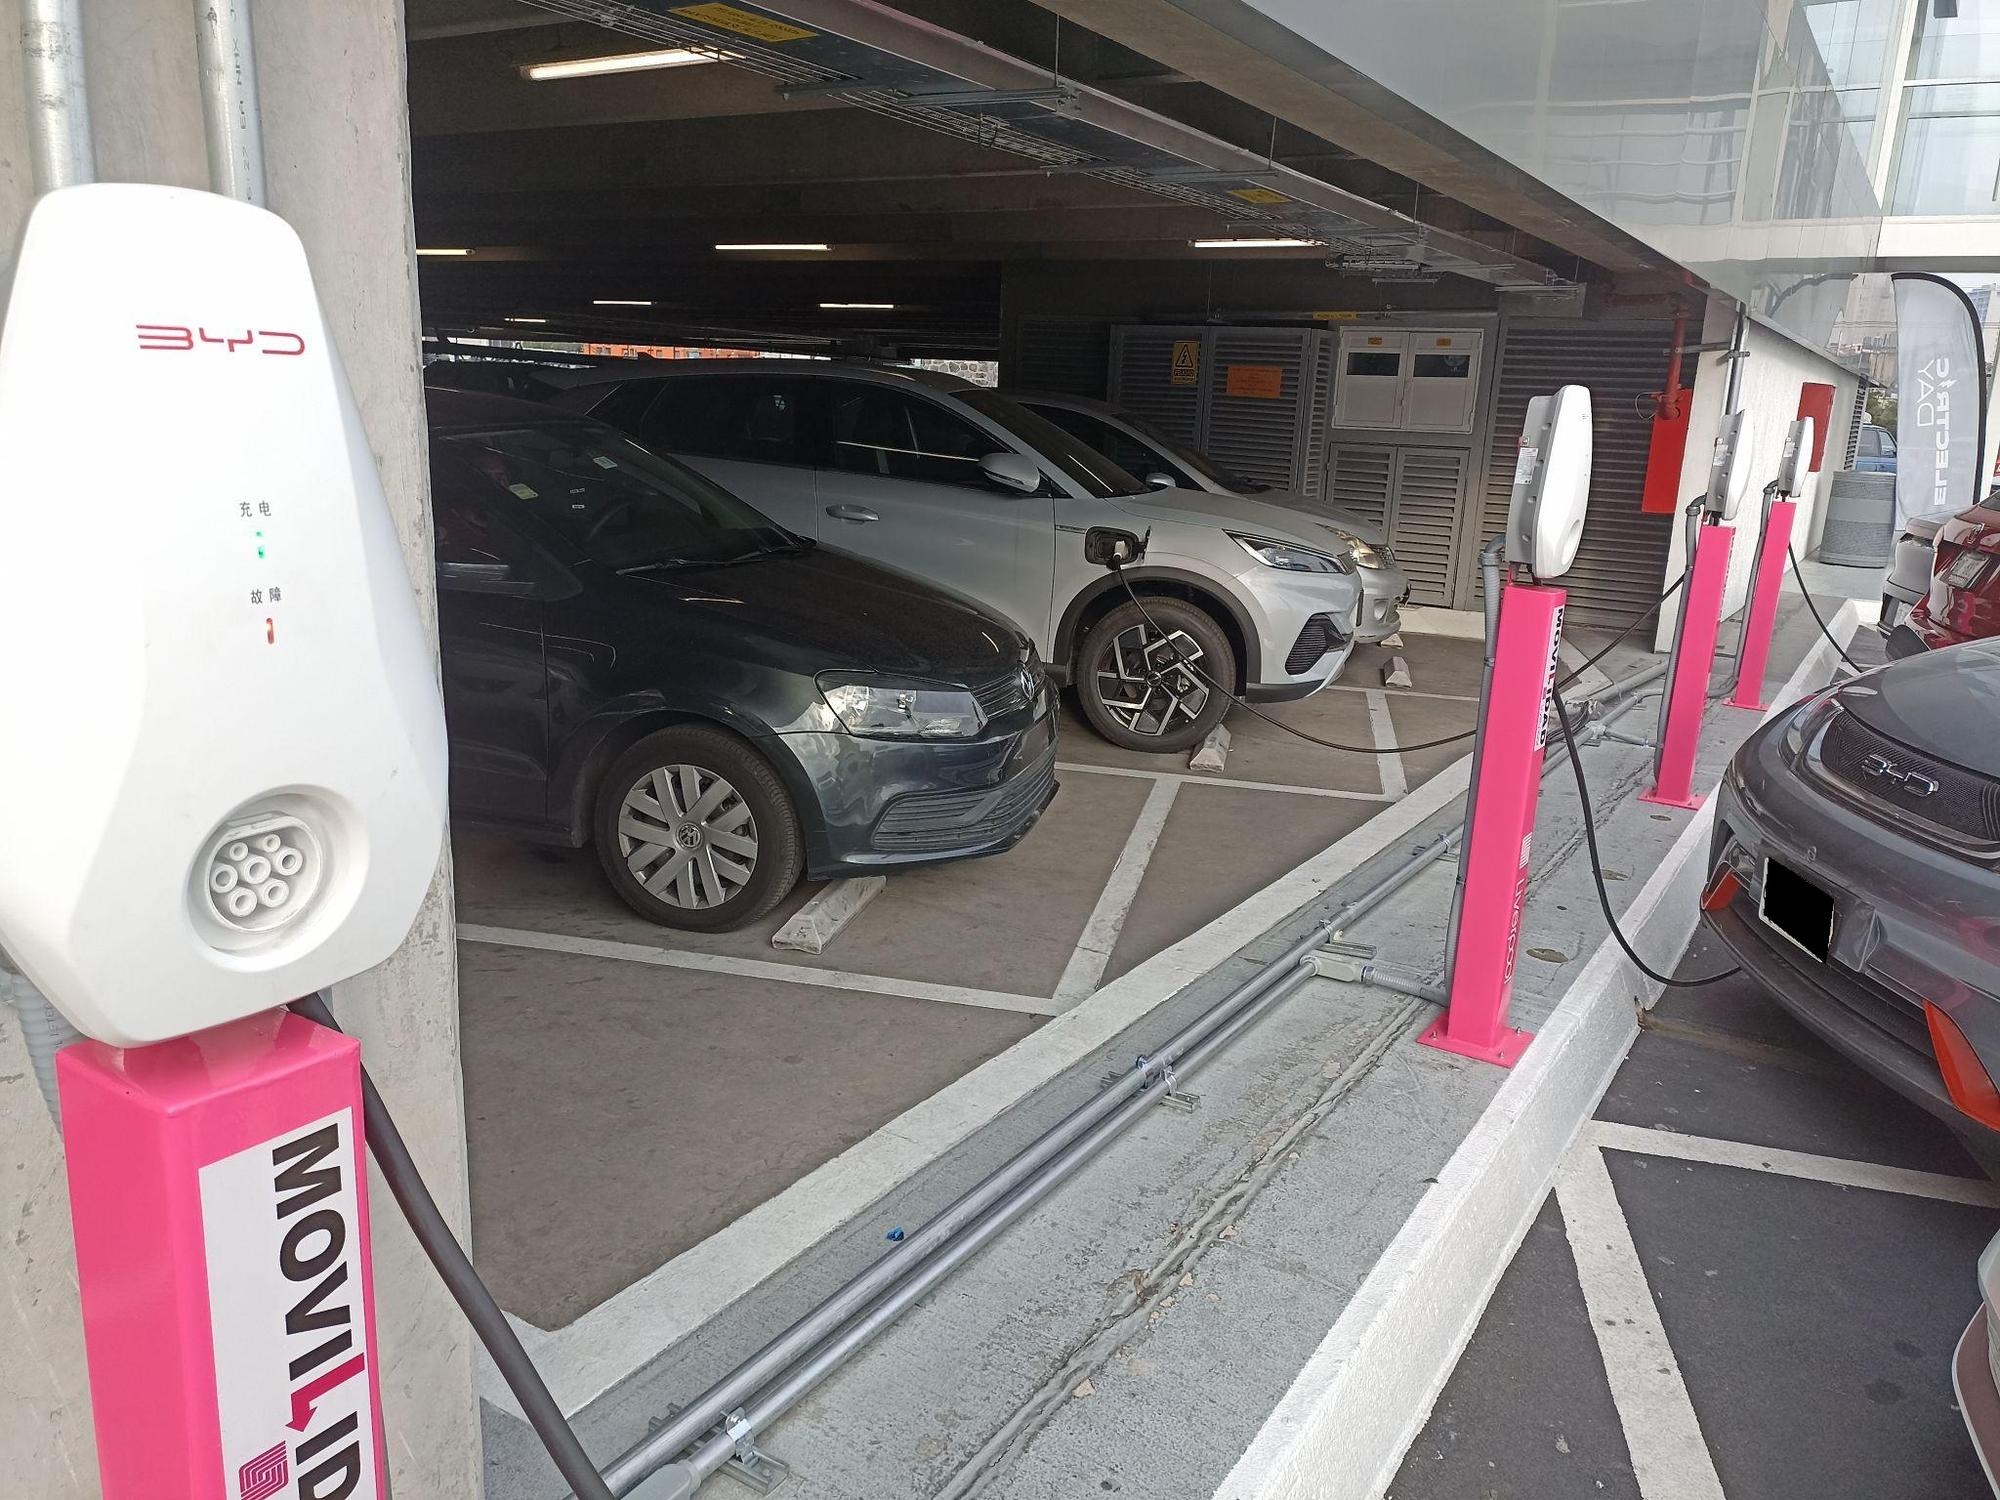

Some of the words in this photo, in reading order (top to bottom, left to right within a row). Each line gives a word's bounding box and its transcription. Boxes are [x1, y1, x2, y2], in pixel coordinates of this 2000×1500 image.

[136, 324, 305, 356] BYD
[239, 500, 272, 518] 充电
[250, 586, 283, 605] 故障
[1539, 608, 1564, 745] MOVILIDAD
[1862, 754, 1940, 797] BYD
